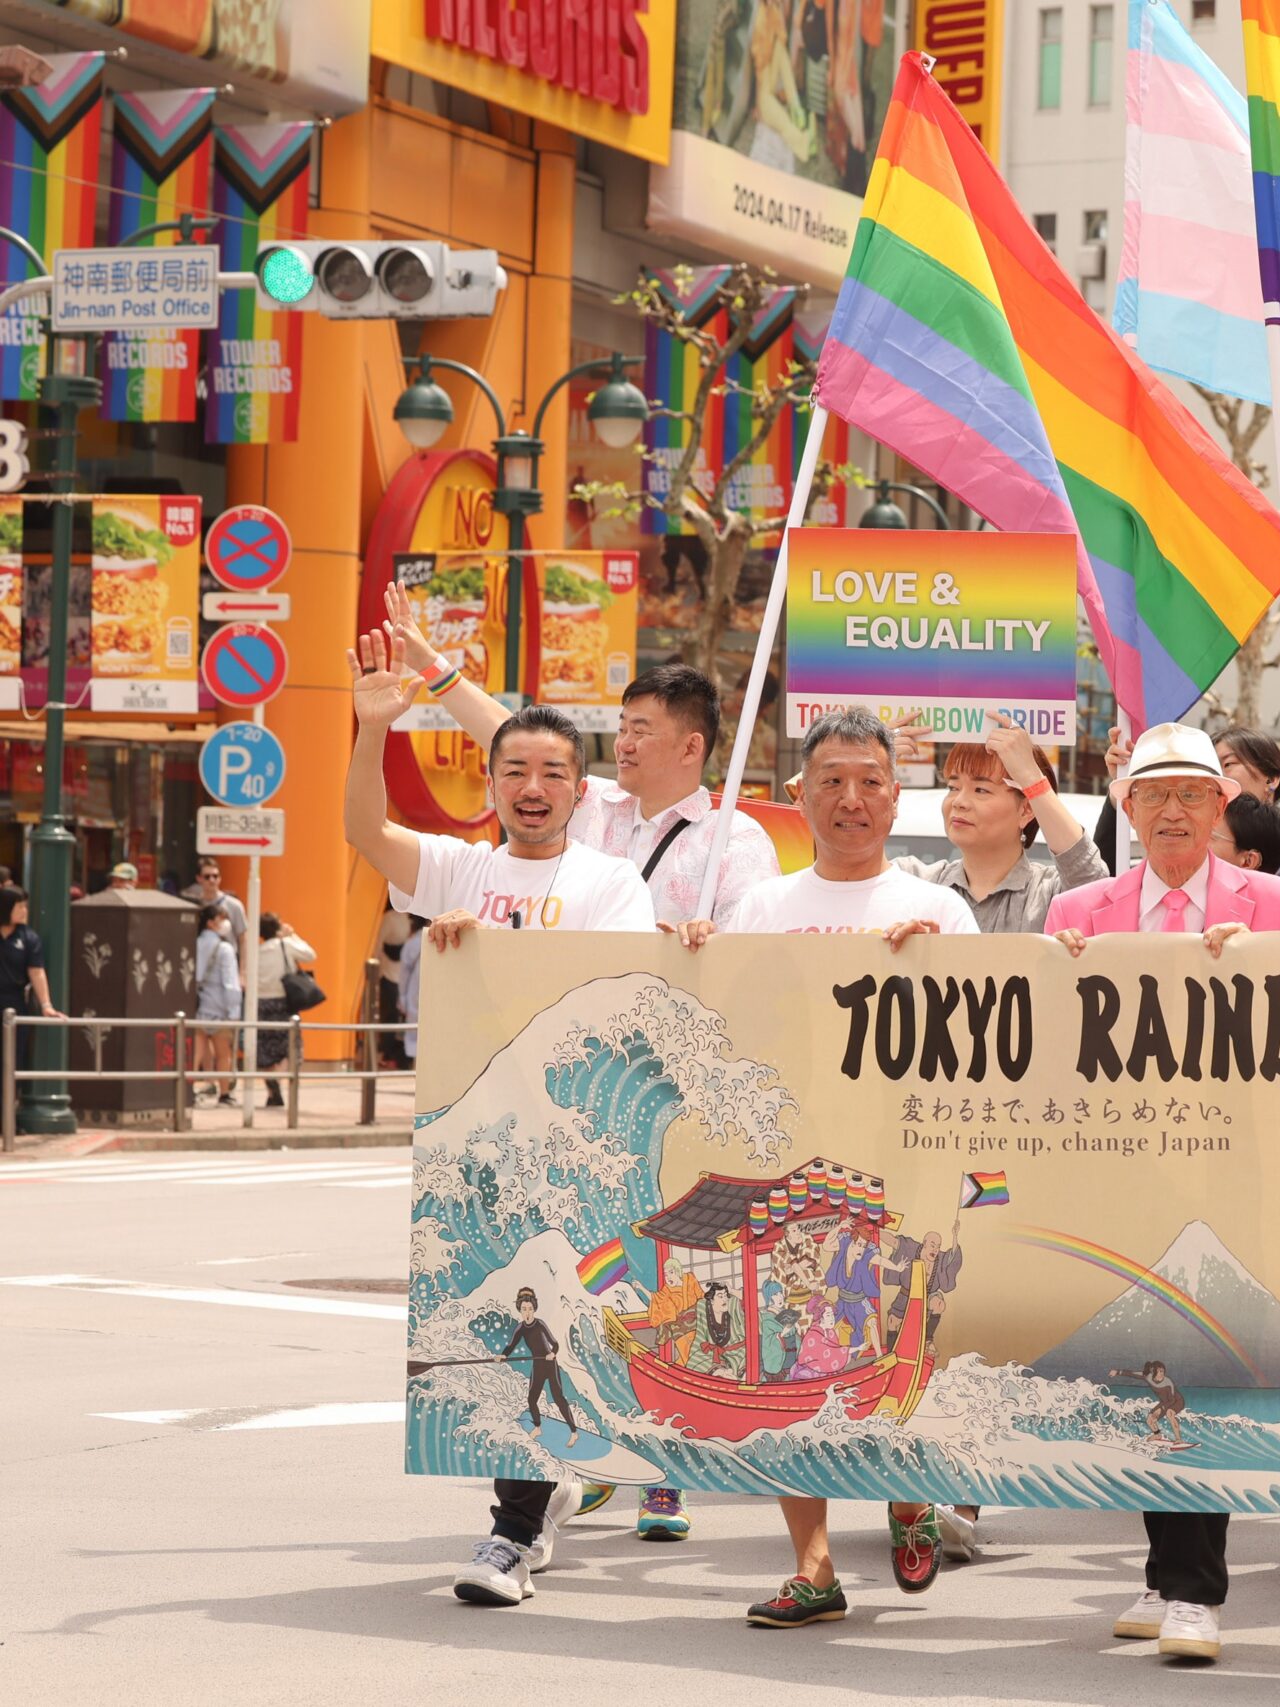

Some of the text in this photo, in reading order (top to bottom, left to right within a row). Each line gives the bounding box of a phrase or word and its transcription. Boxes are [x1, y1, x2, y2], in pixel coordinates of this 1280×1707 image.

[733, 183, 849, 248] 2024.04.17 Release
[63, 259, 210, 295] 神南郵便局前
[59, 297, 211, 320] Jin-nan Post Office
[108, 342, 188, 369] RECORDS
[220, 339, 282, 367] TOWER
[213, 366, 293, 394] RECORDS
[166, 522, 195, 536] No.1
[811, 570, 961, 605] LOVE &
[846, 615, 1051, 652] EQUALITY
[219, 745, 252, 798] P
[478, 889, 564, 929] TOKYO
[832, 973, 1033, 1083] TOKYO
[899, 1093, 1233, 1126] 変わるまで、あきらめない。
[902, 1128, 1232, 1158] Don't give up, change Japan
